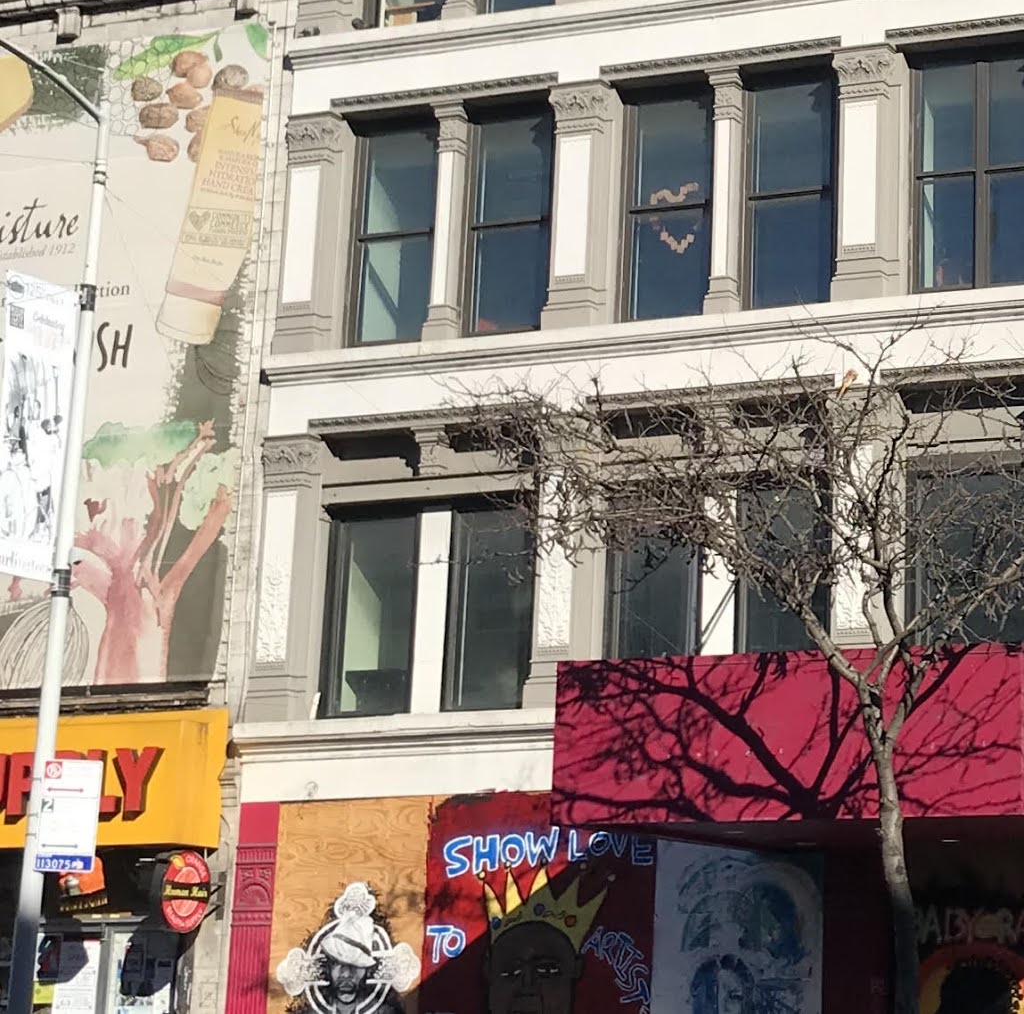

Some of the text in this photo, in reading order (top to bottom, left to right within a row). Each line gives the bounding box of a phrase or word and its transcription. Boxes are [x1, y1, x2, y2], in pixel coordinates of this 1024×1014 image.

[443, 825, 654, 878] SHOW LOVE
[426, 924, 467, 964] TO
[580, 925, 651, 1014] ARTIST
